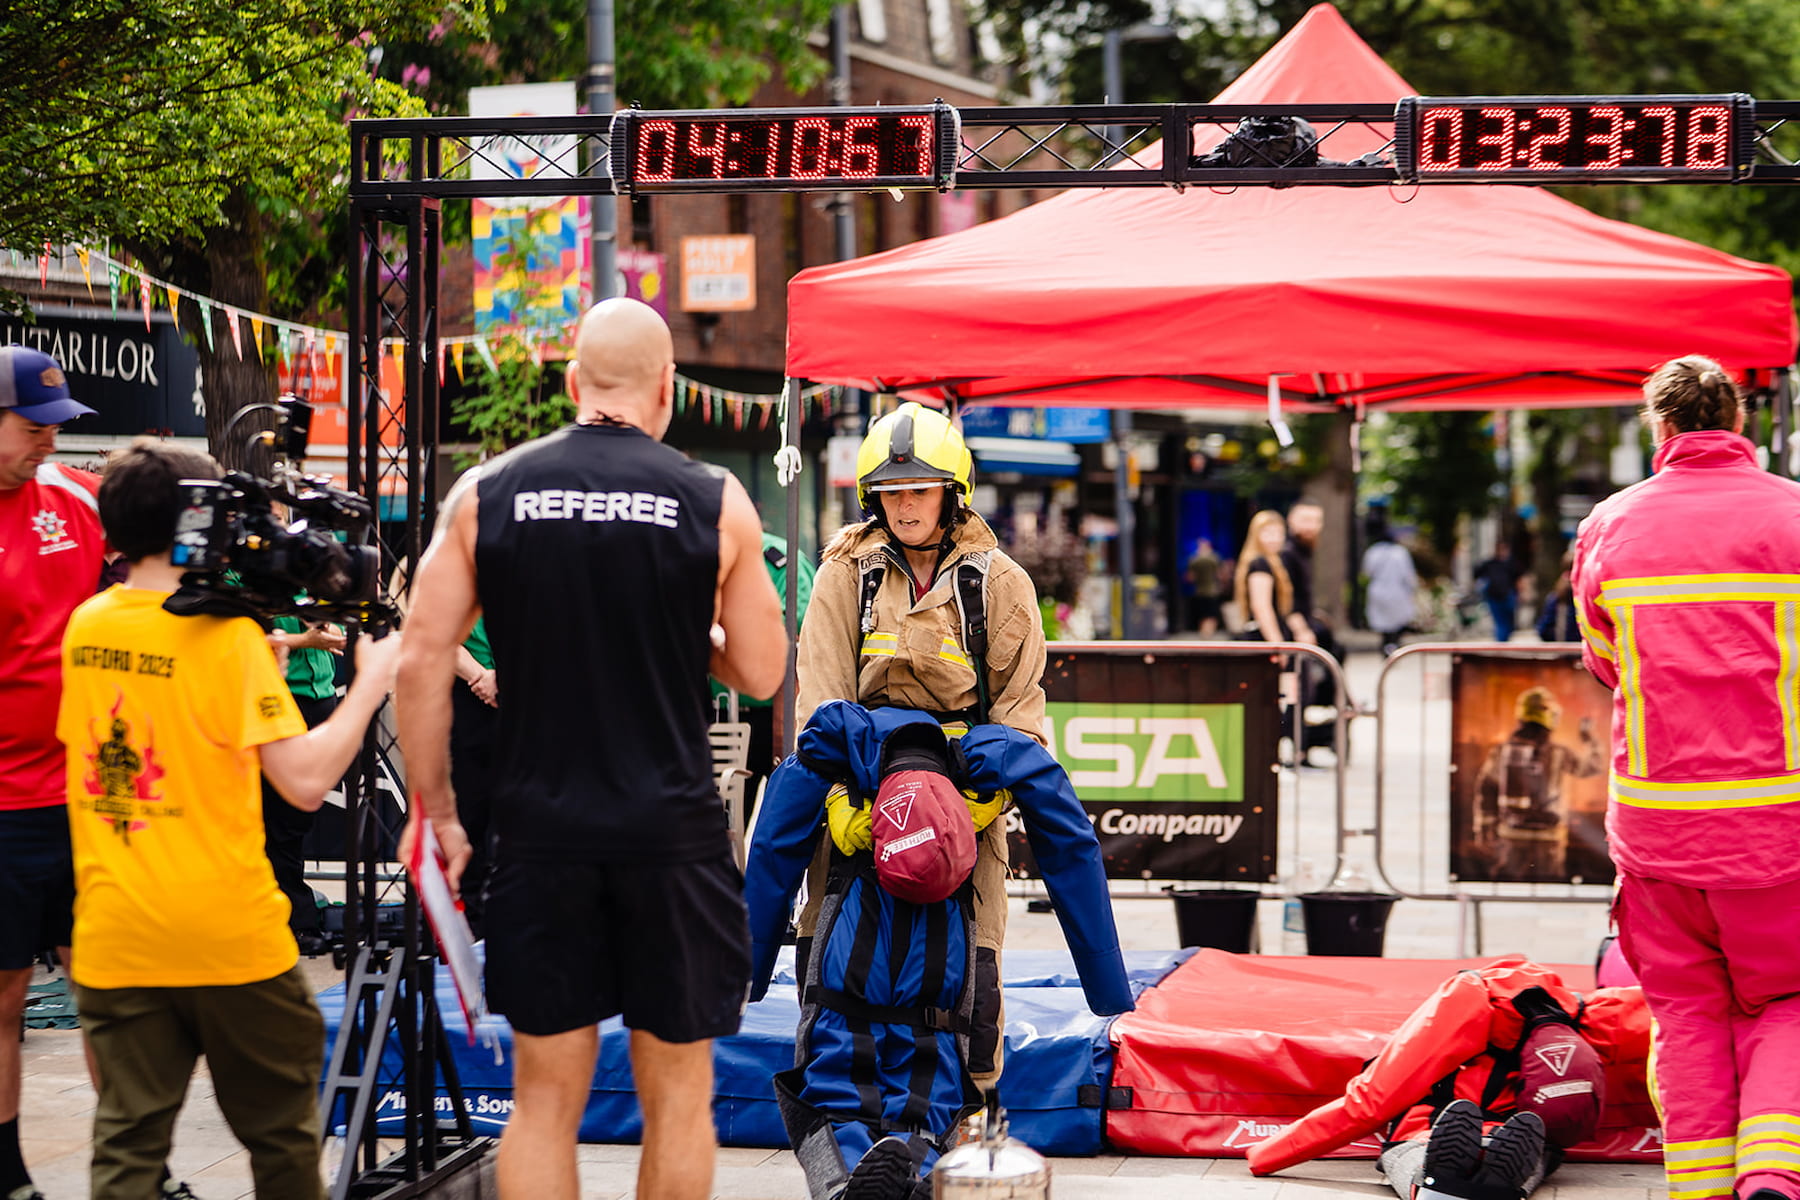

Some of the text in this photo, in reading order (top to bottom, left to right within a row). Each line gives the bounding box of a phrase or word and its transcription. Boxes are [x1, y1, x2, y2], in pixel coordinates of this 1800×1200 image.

[633, 116, 932, 183] 04:10:67
[1421, 106, 1730, 171] 03:23:78
[514, 489, 680, 528] REFEREE
[1044, 716, 1228, 788] SA
[1100, 808, 1244, 844] Company
